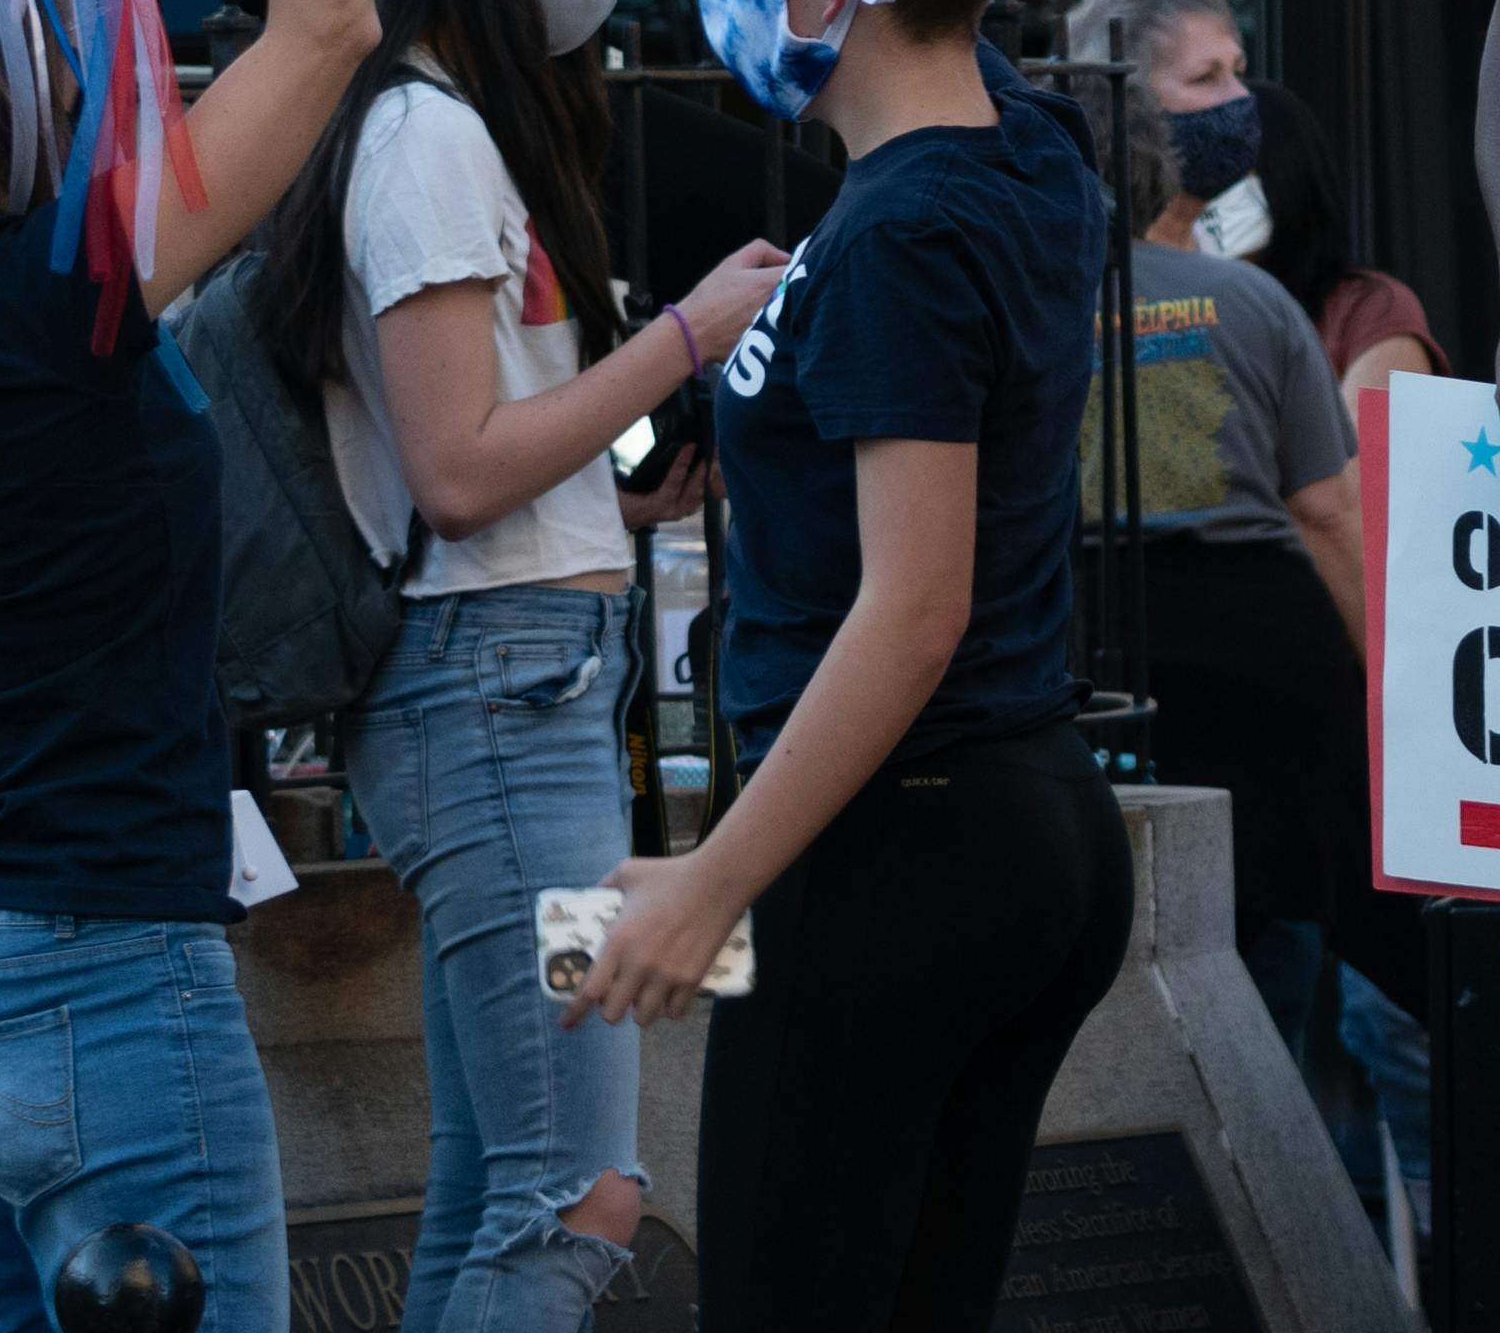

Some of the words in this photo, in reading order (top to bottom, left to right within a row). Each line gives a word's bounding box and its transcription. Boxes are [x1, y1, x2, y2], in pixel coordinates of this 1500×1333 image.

[1133, 296, 1220, 336] ELPHIA
[627, 731, 648, 797] Nikon
[1013, 1219, 1063, 1246] less
[290, 1247, 412, 1333] WOR
